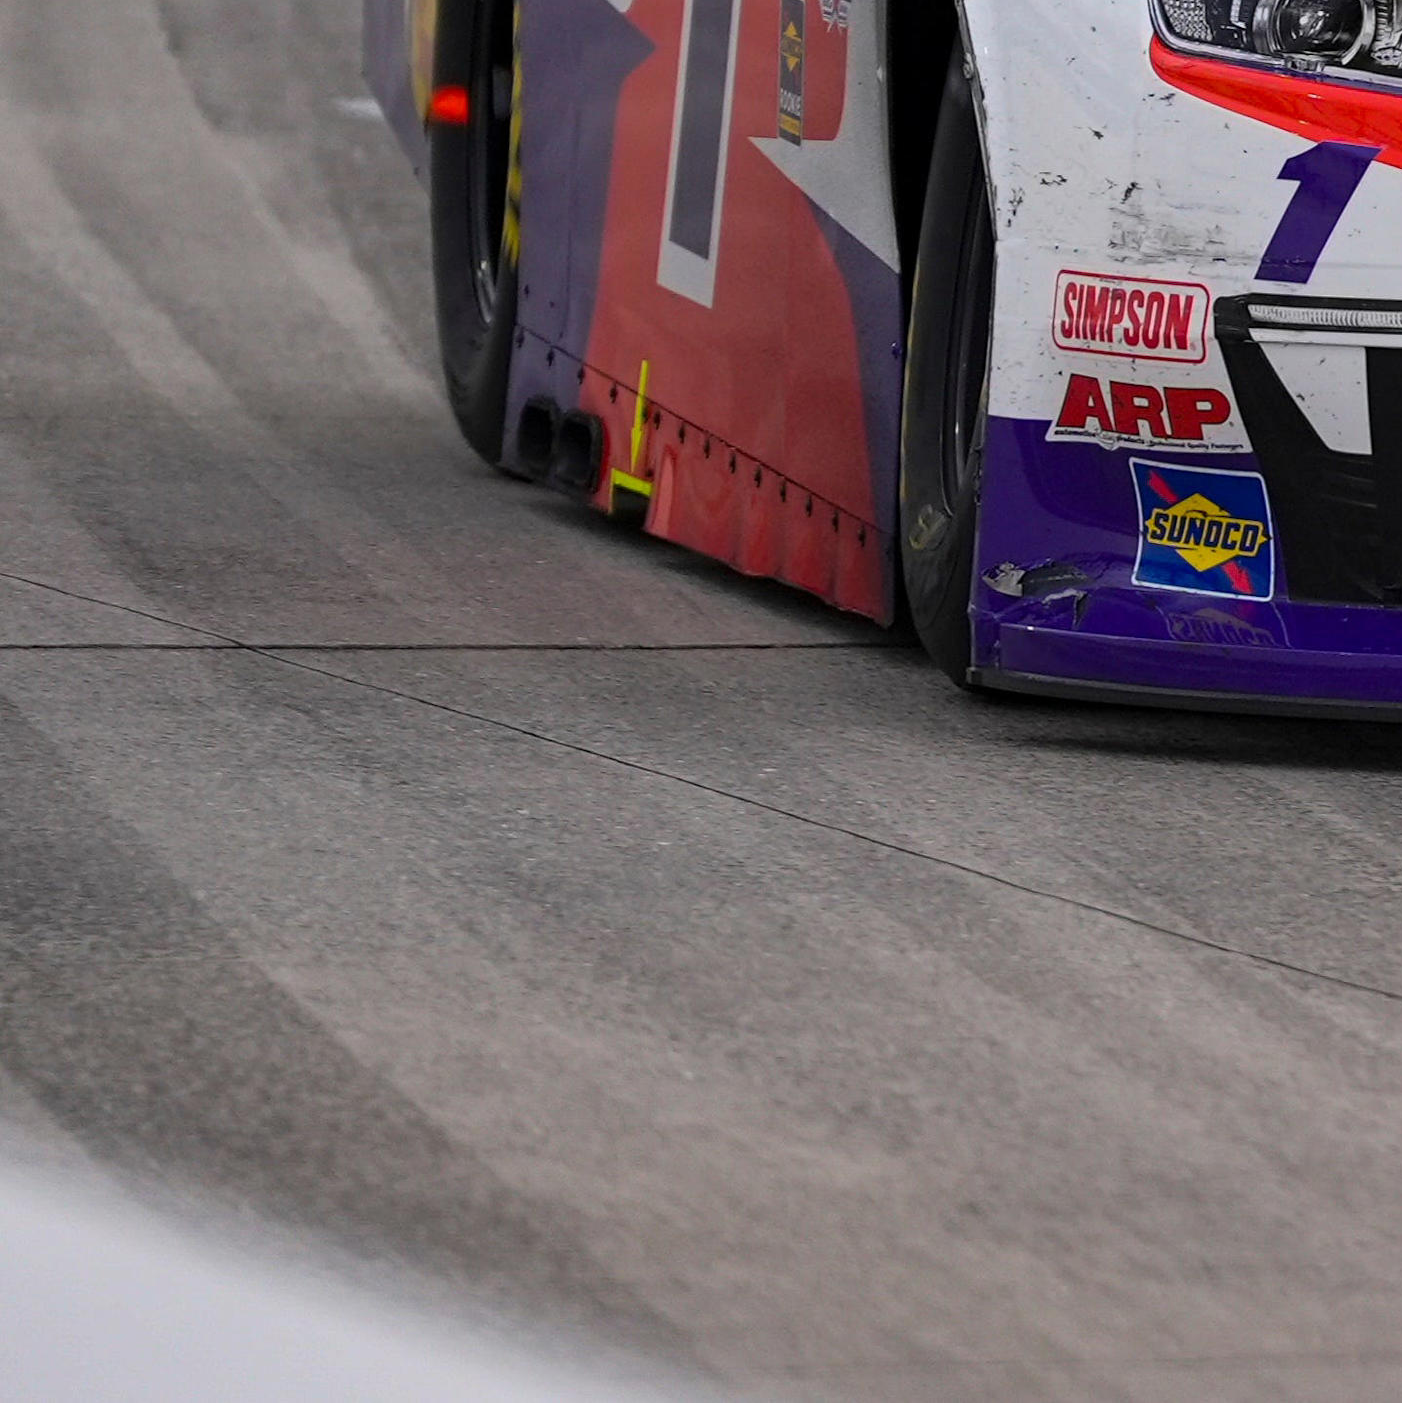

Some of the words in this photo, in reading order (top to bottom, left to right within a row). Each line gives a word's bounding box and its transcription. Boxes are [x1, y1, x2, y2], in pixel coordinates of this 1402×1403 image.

[1253, 141, 1388, 285] 1
[1060, 282, 1195, 350] SIMPSON
[1056, 374, 1232, 440] ARP
[1151, 511, 1259, 555] SUNOCO
